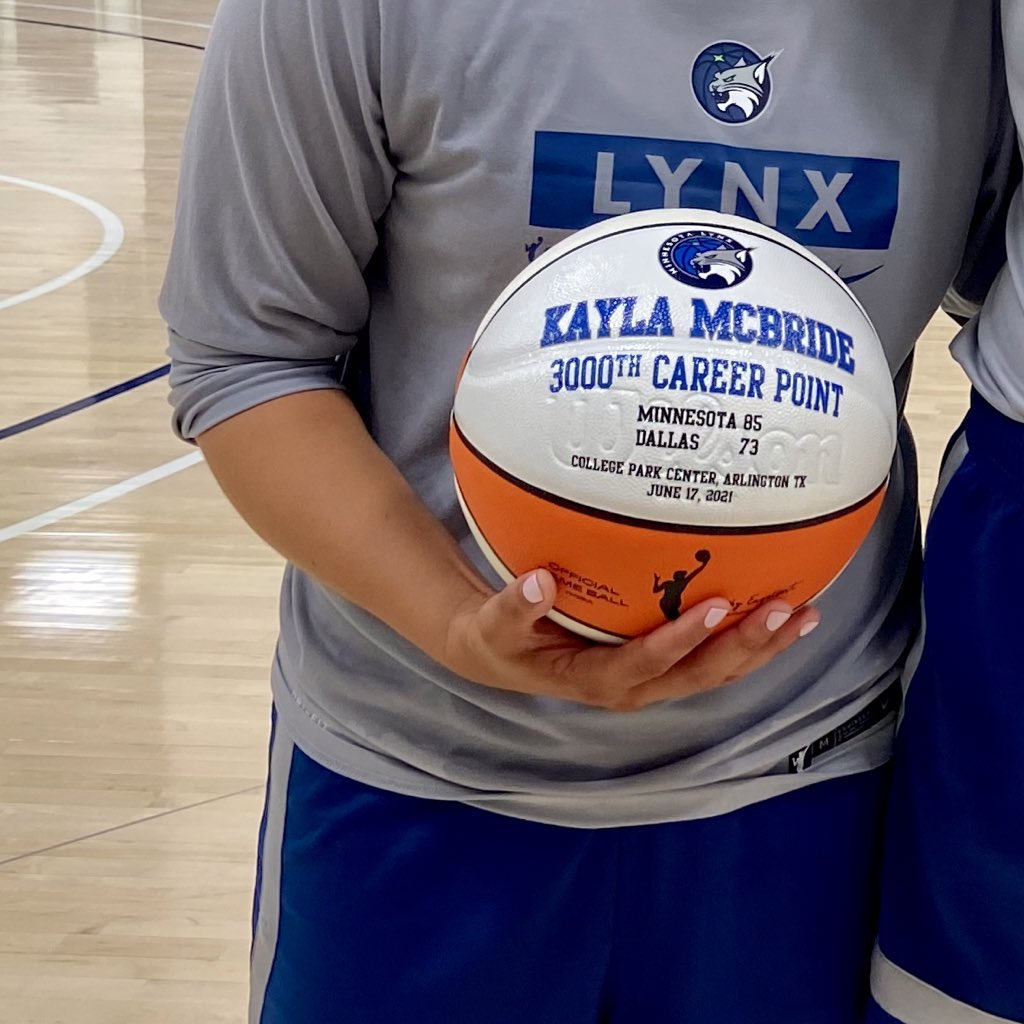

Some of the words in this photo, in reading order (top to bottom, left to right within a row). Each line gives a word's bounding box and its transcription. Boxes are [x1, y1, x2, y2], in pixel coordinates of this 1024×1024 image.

[593, 152, 854, 233] LYNX
[540, 296, 675, 348] KAYLA
[690, 297, 856, 375] MCBRIDE
[652, 355, 767, 399] CAREER
[773, 367, 844, 418] POINT
[636, 405, 738, 430] MINNESOTA
[743, 414, 763, 431] 85
[635, 429, 700, 451] DALLAS
[738, 438, 760, 456] 73
[571, 454, 625, 475] COLLEGE
[628, 463, 663, 480] PARK
[666, 467, 719, 487] CENTER,
[723, 472, 790, 489] ARLINGTON
[794, 475, 807, 488] TX
[646, 483, 682, 499] JUNE
[685, 488, 701, 503] 17,
[706, 489, 733, 504] 2021
[548, 562, 620, 596] OFFICIAL
[586, 588, 629, 607] BALL
